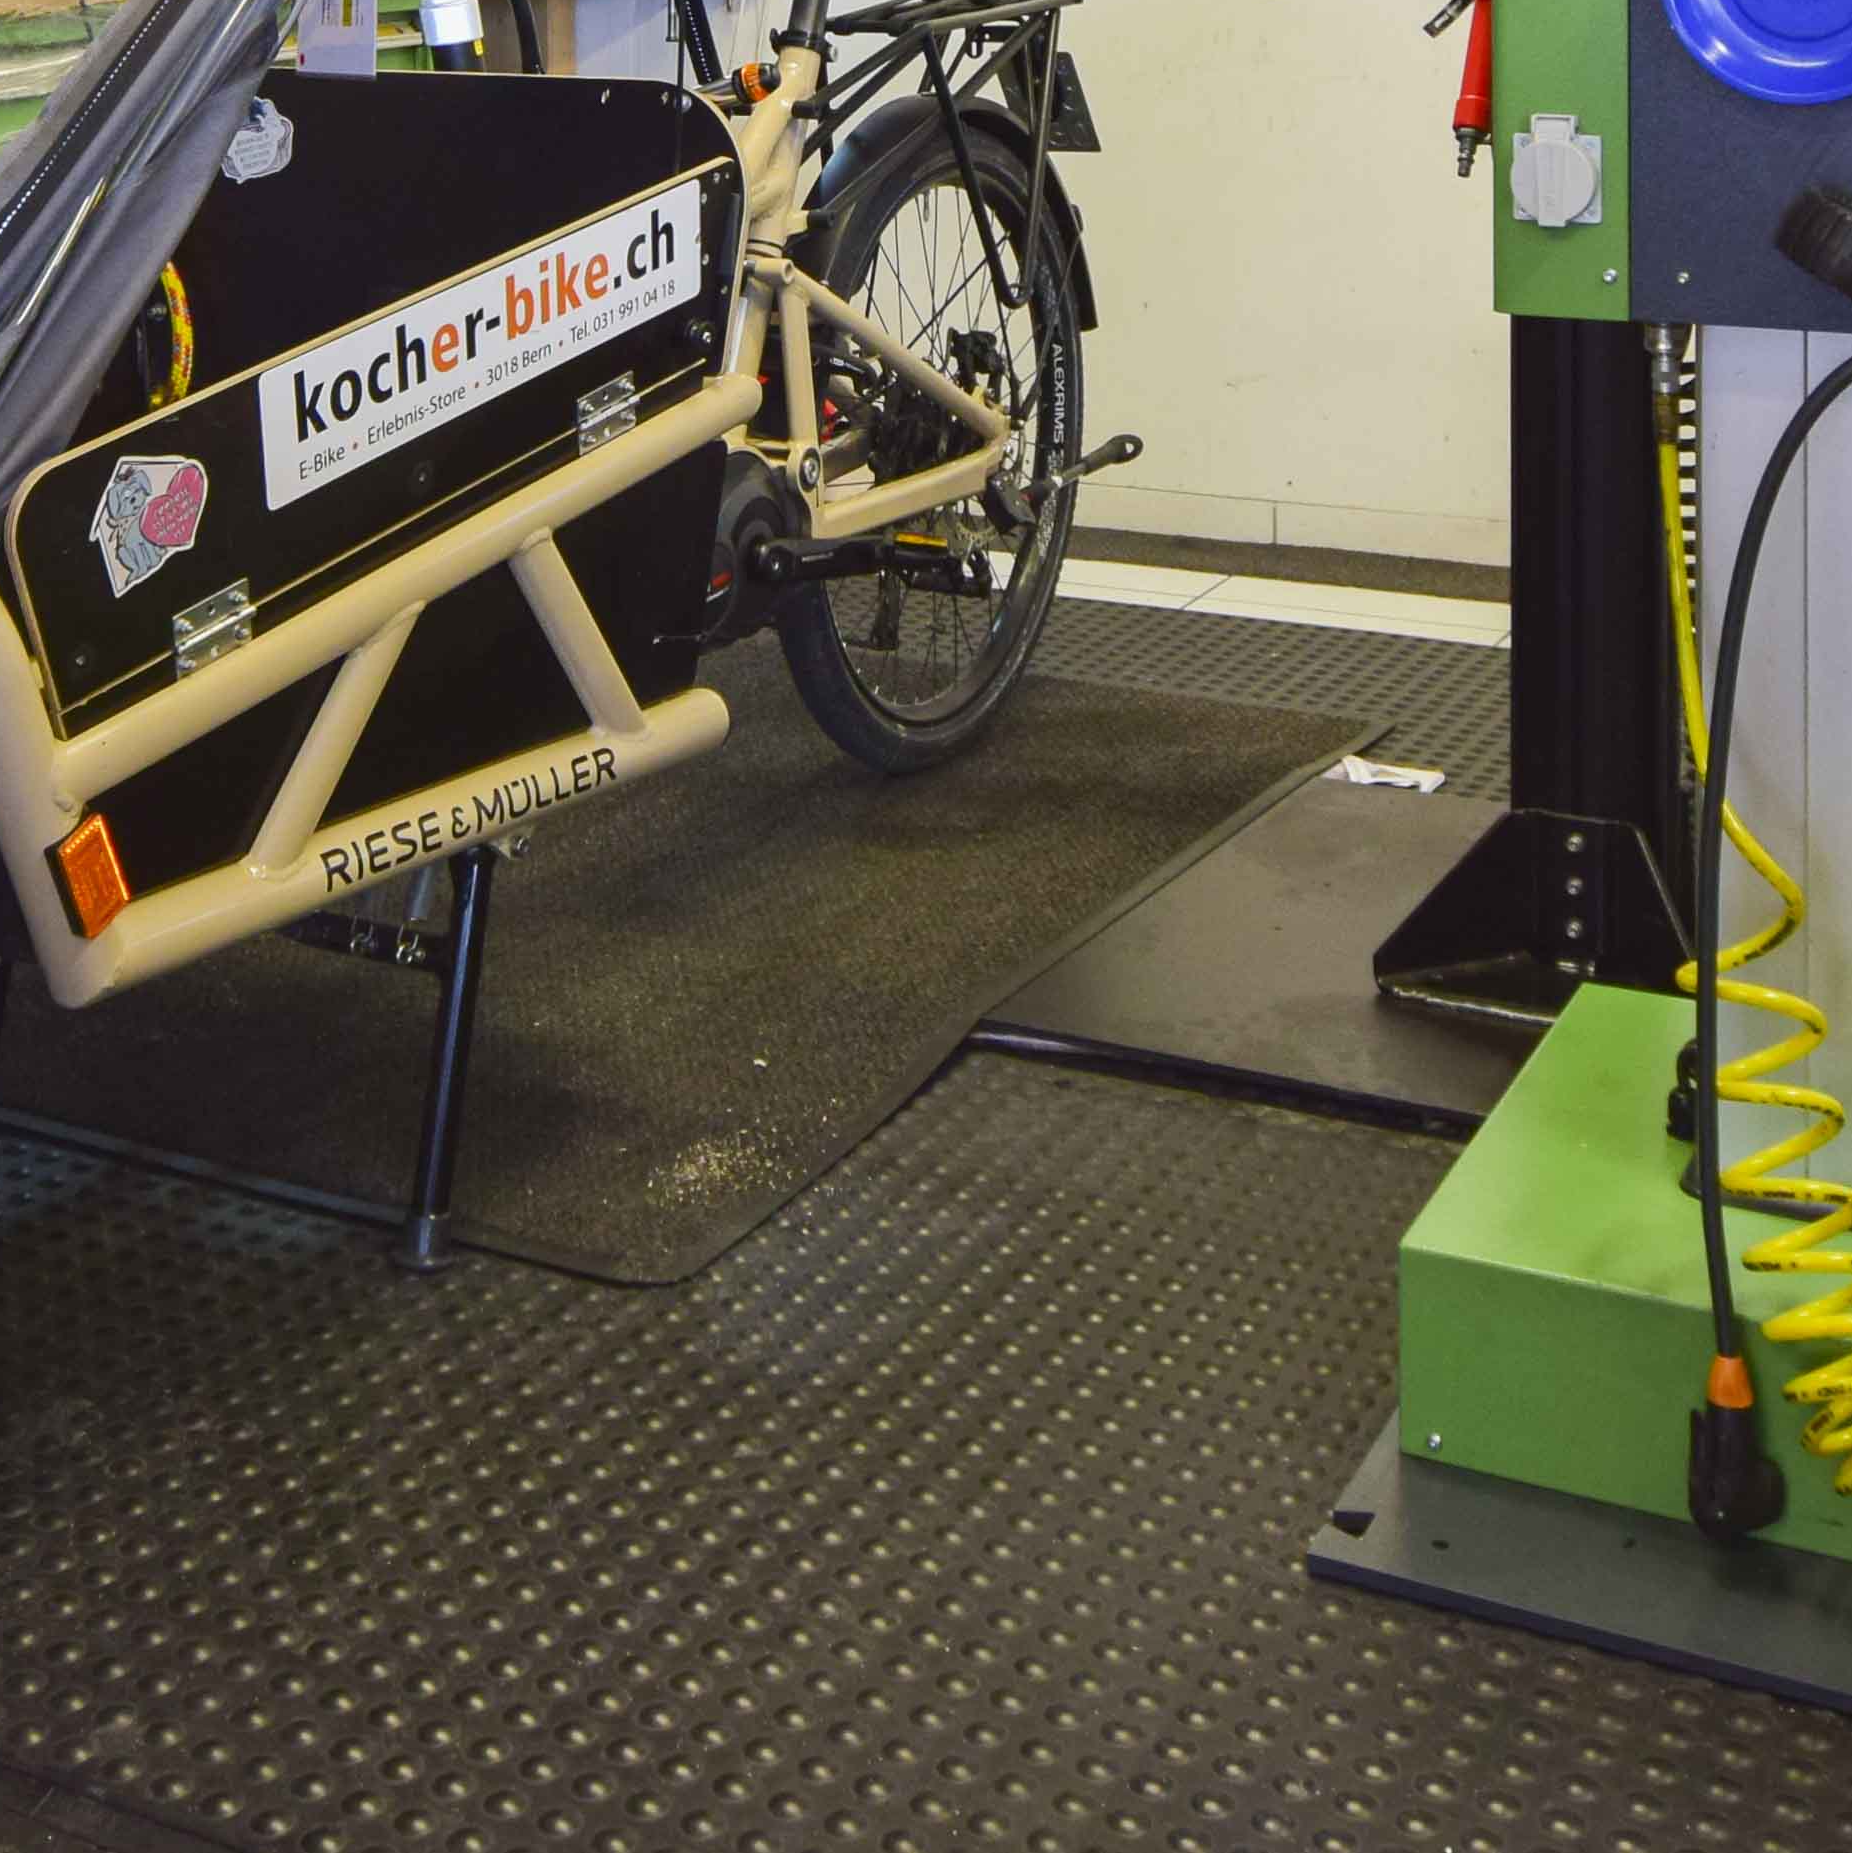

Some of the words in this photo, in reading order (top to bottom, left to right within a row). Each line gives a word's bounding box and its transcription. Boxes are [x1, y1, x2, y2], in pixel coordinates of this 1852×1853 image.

[292, 209, 675, 443] kocher-bike.ch
[298, 443, 347, 481] E-Bike
[366, 382, 467, 446] Erlebnis-Store
[485, 356, 520, 387] 3018
[522, 343, 553, 369] Bern
[570, 322, 592, 345] Tel.
[593, 310, 616, 334] 031
[618, 296, 640, 321] 991
[644, 288, 660, 308] 04
[661, 278, 676, 300] 18
[321, 808, 444, 893] RIESE
[450, 804, 472, 838] &
[473, 746, 618, 827] MÜLLER
